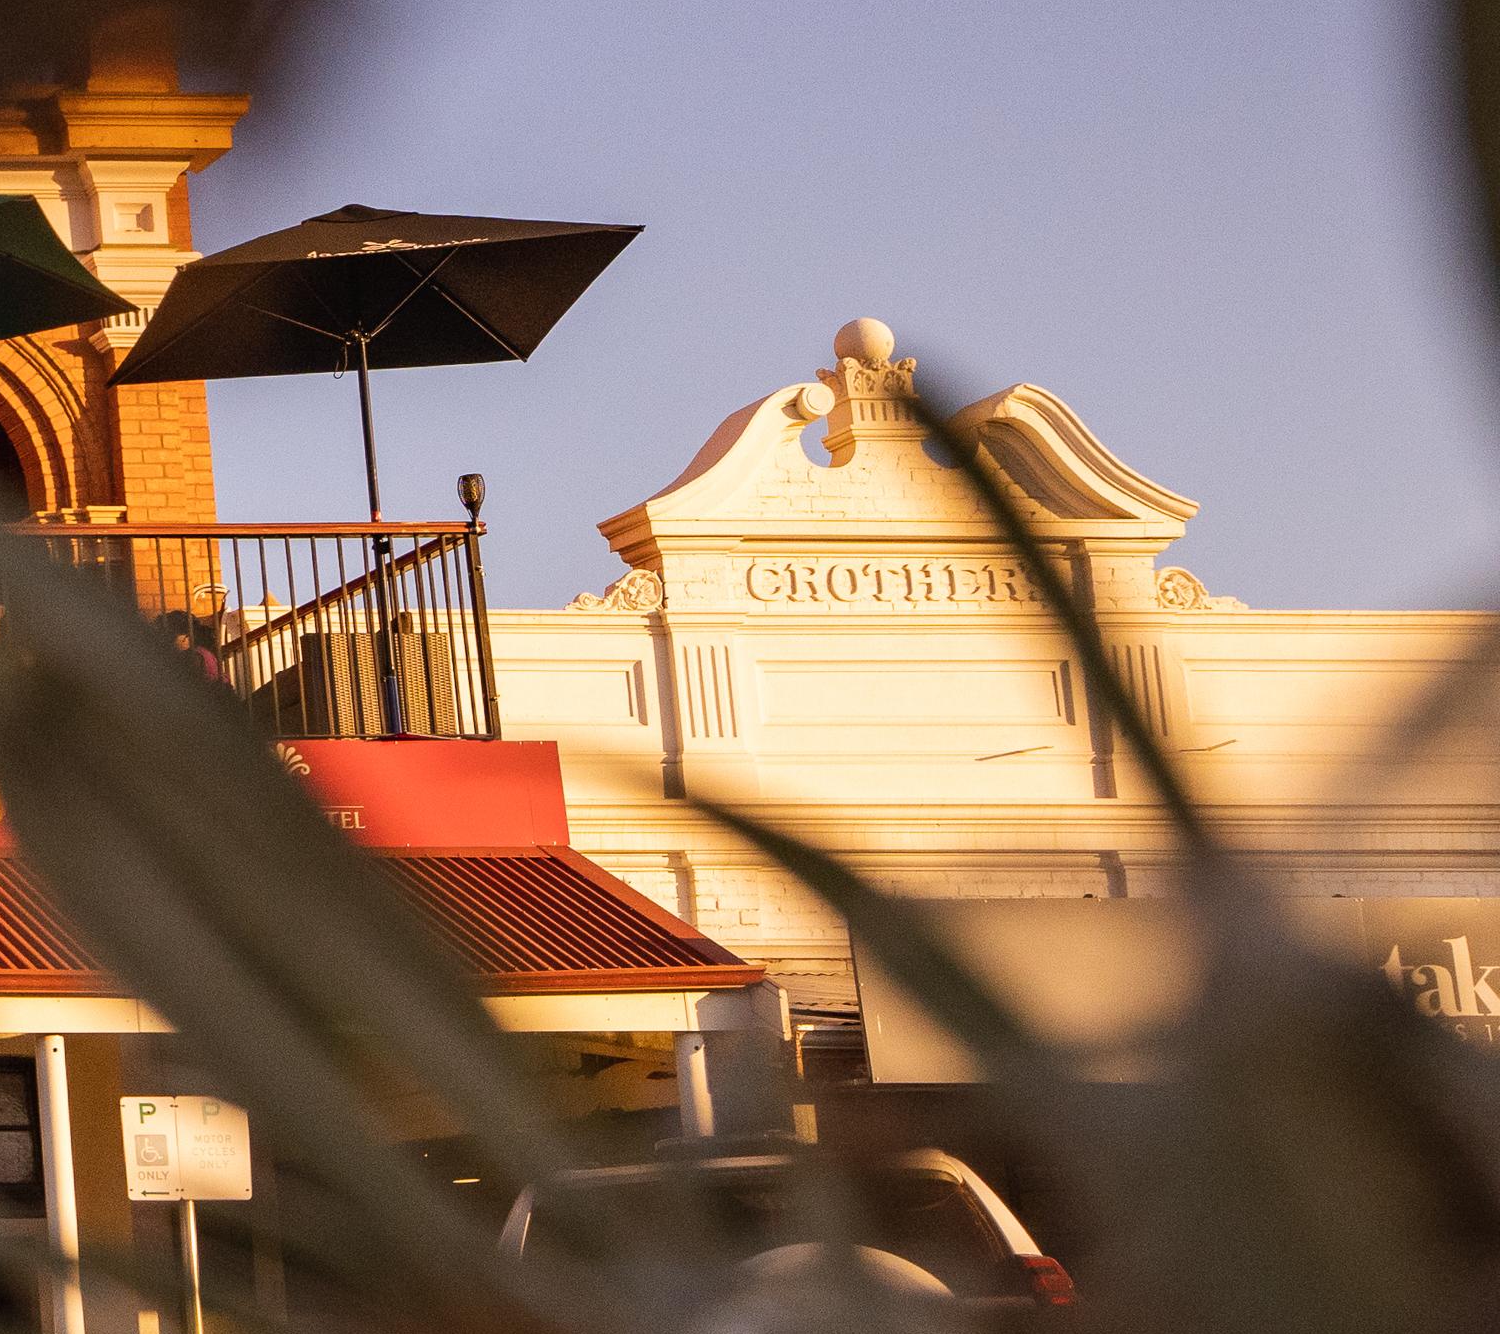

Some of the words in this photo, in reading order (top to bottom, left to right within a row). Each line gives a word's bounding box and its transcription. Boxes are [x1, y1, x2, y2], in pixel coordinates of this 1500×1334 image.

[745, 563, 1042, 603] CROTHER
[139, 1102, 157, 1124] P
[201, 1103, 221, 1125] P
[194, 1134, 233, 1143] MOTOR
[192, 1147, 237, 1156] CYCLES
[200, 1160, 230, 1169] ONLY
[138, 1171, 170, 1181] ONLY
